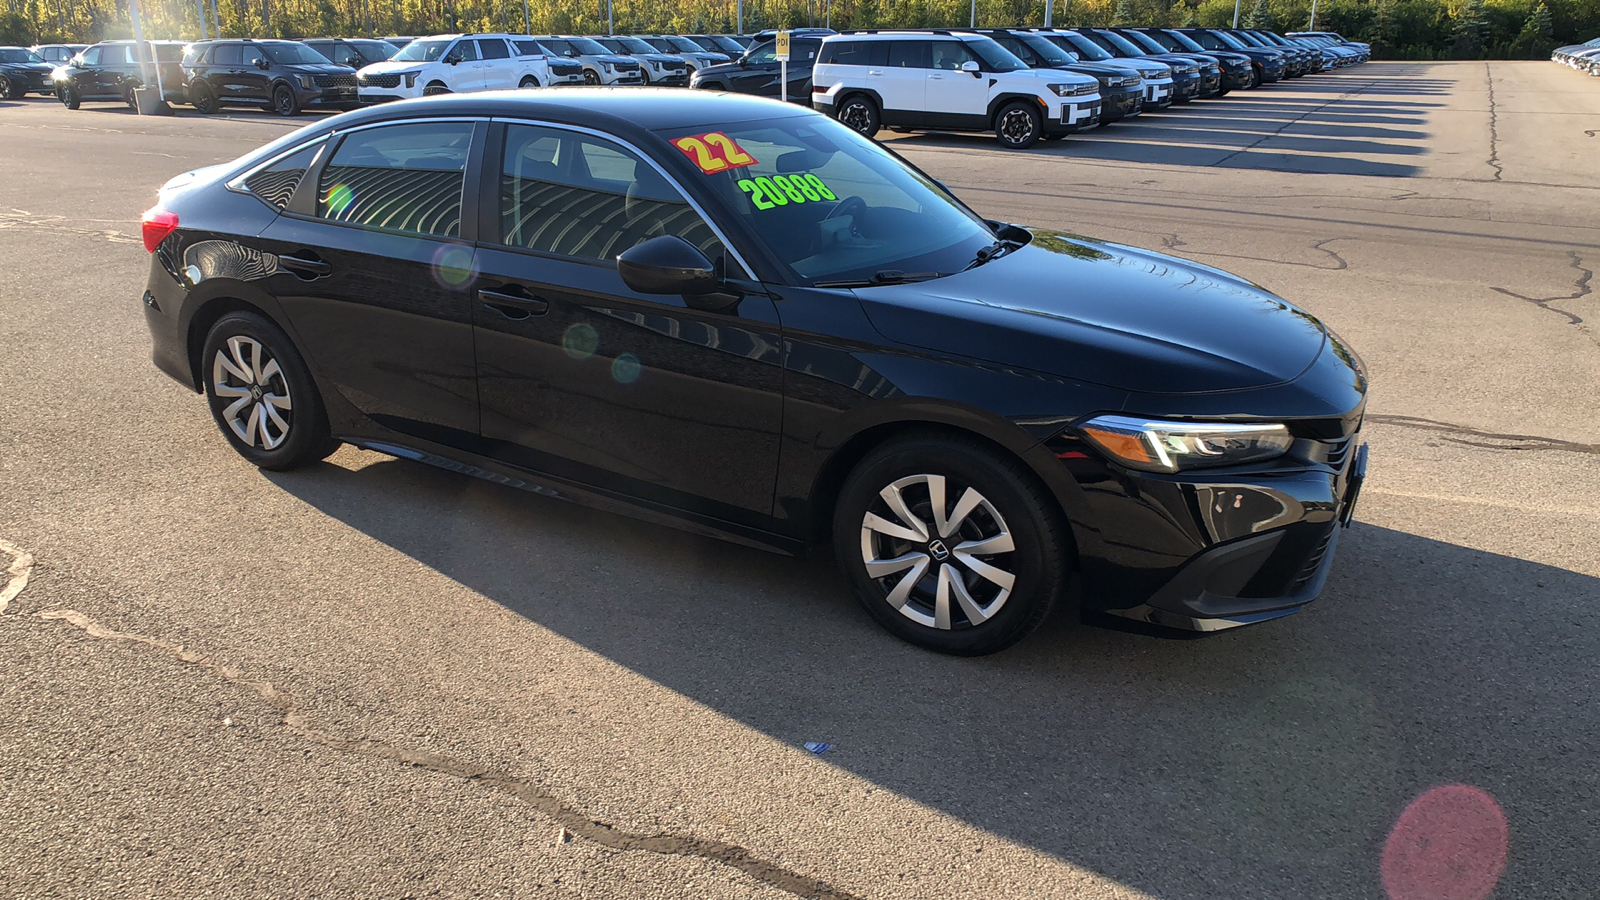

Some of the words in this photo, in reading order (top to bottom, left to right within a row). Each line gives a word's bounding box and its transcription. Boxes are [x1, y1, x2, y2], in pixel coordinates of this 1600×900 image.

[777, 38, 788, 46] PDI
[677, 133, 753, 171] 22
[738, 173, 836, 210] 20888
